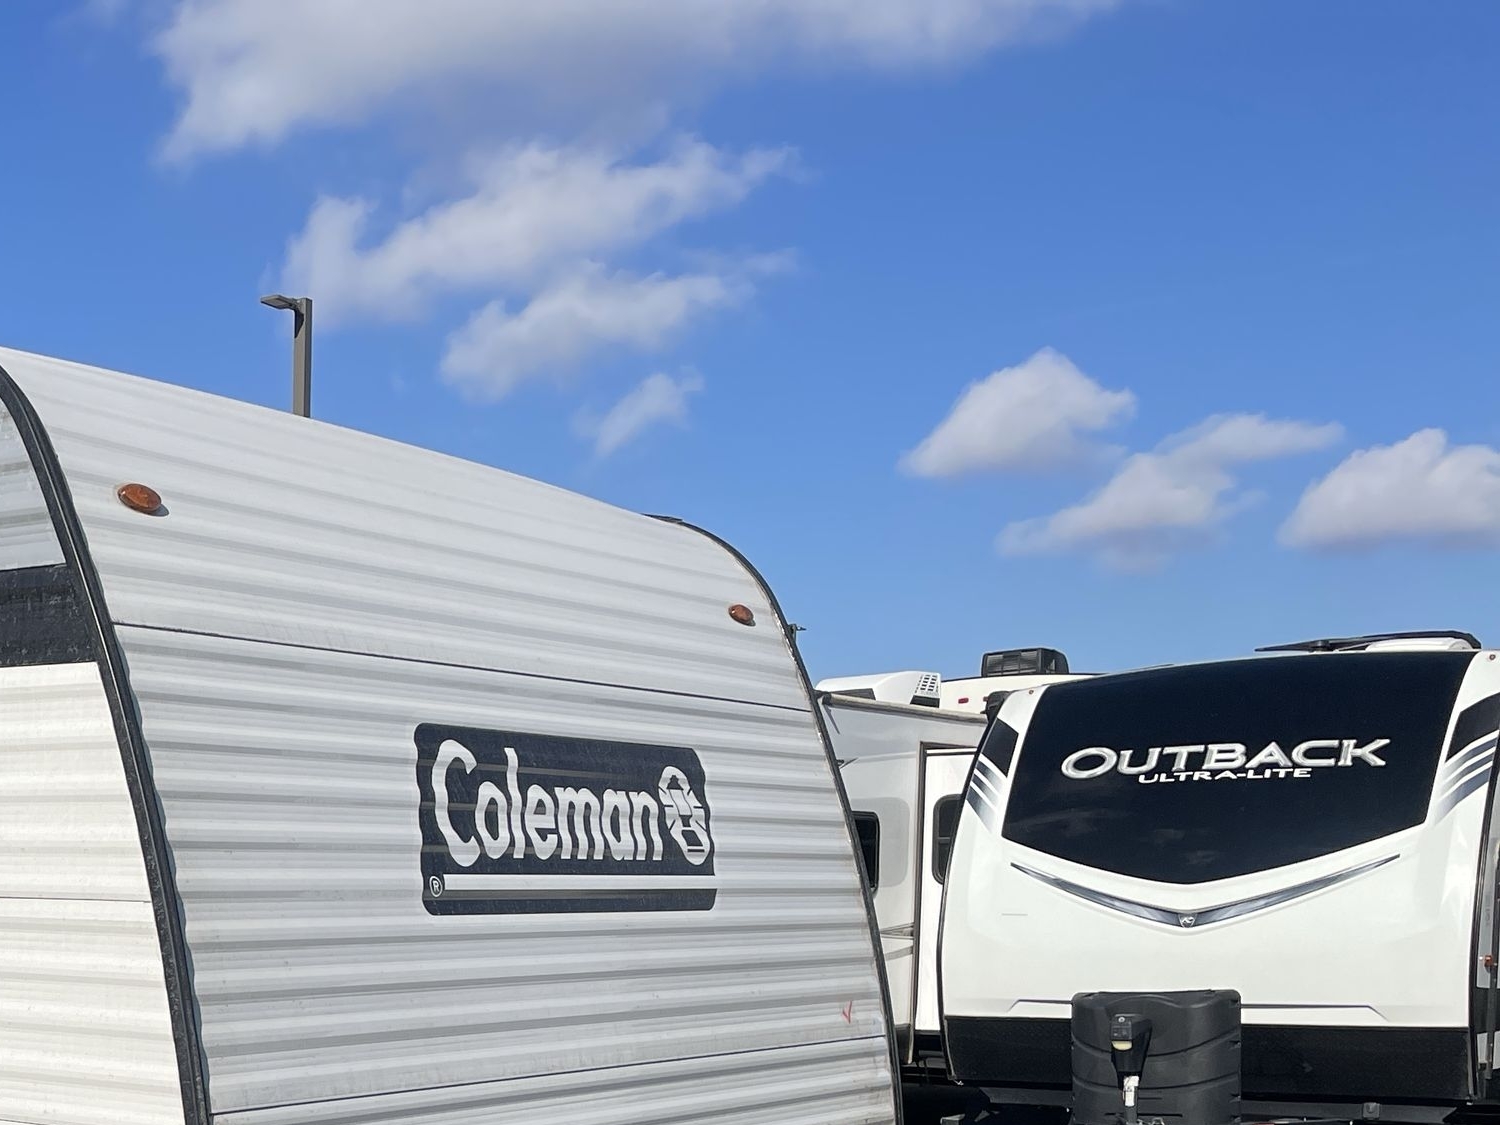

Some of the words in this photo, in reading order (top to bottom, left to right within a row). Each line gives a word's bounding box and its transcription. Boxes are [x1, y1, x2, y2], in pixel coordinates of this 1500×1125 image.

[1061, 738, 1391, 779] OUTBACK
[1138, 768, 1312, 784] ULTRA-LITE
[431, 738, 664, 868] Coleman
